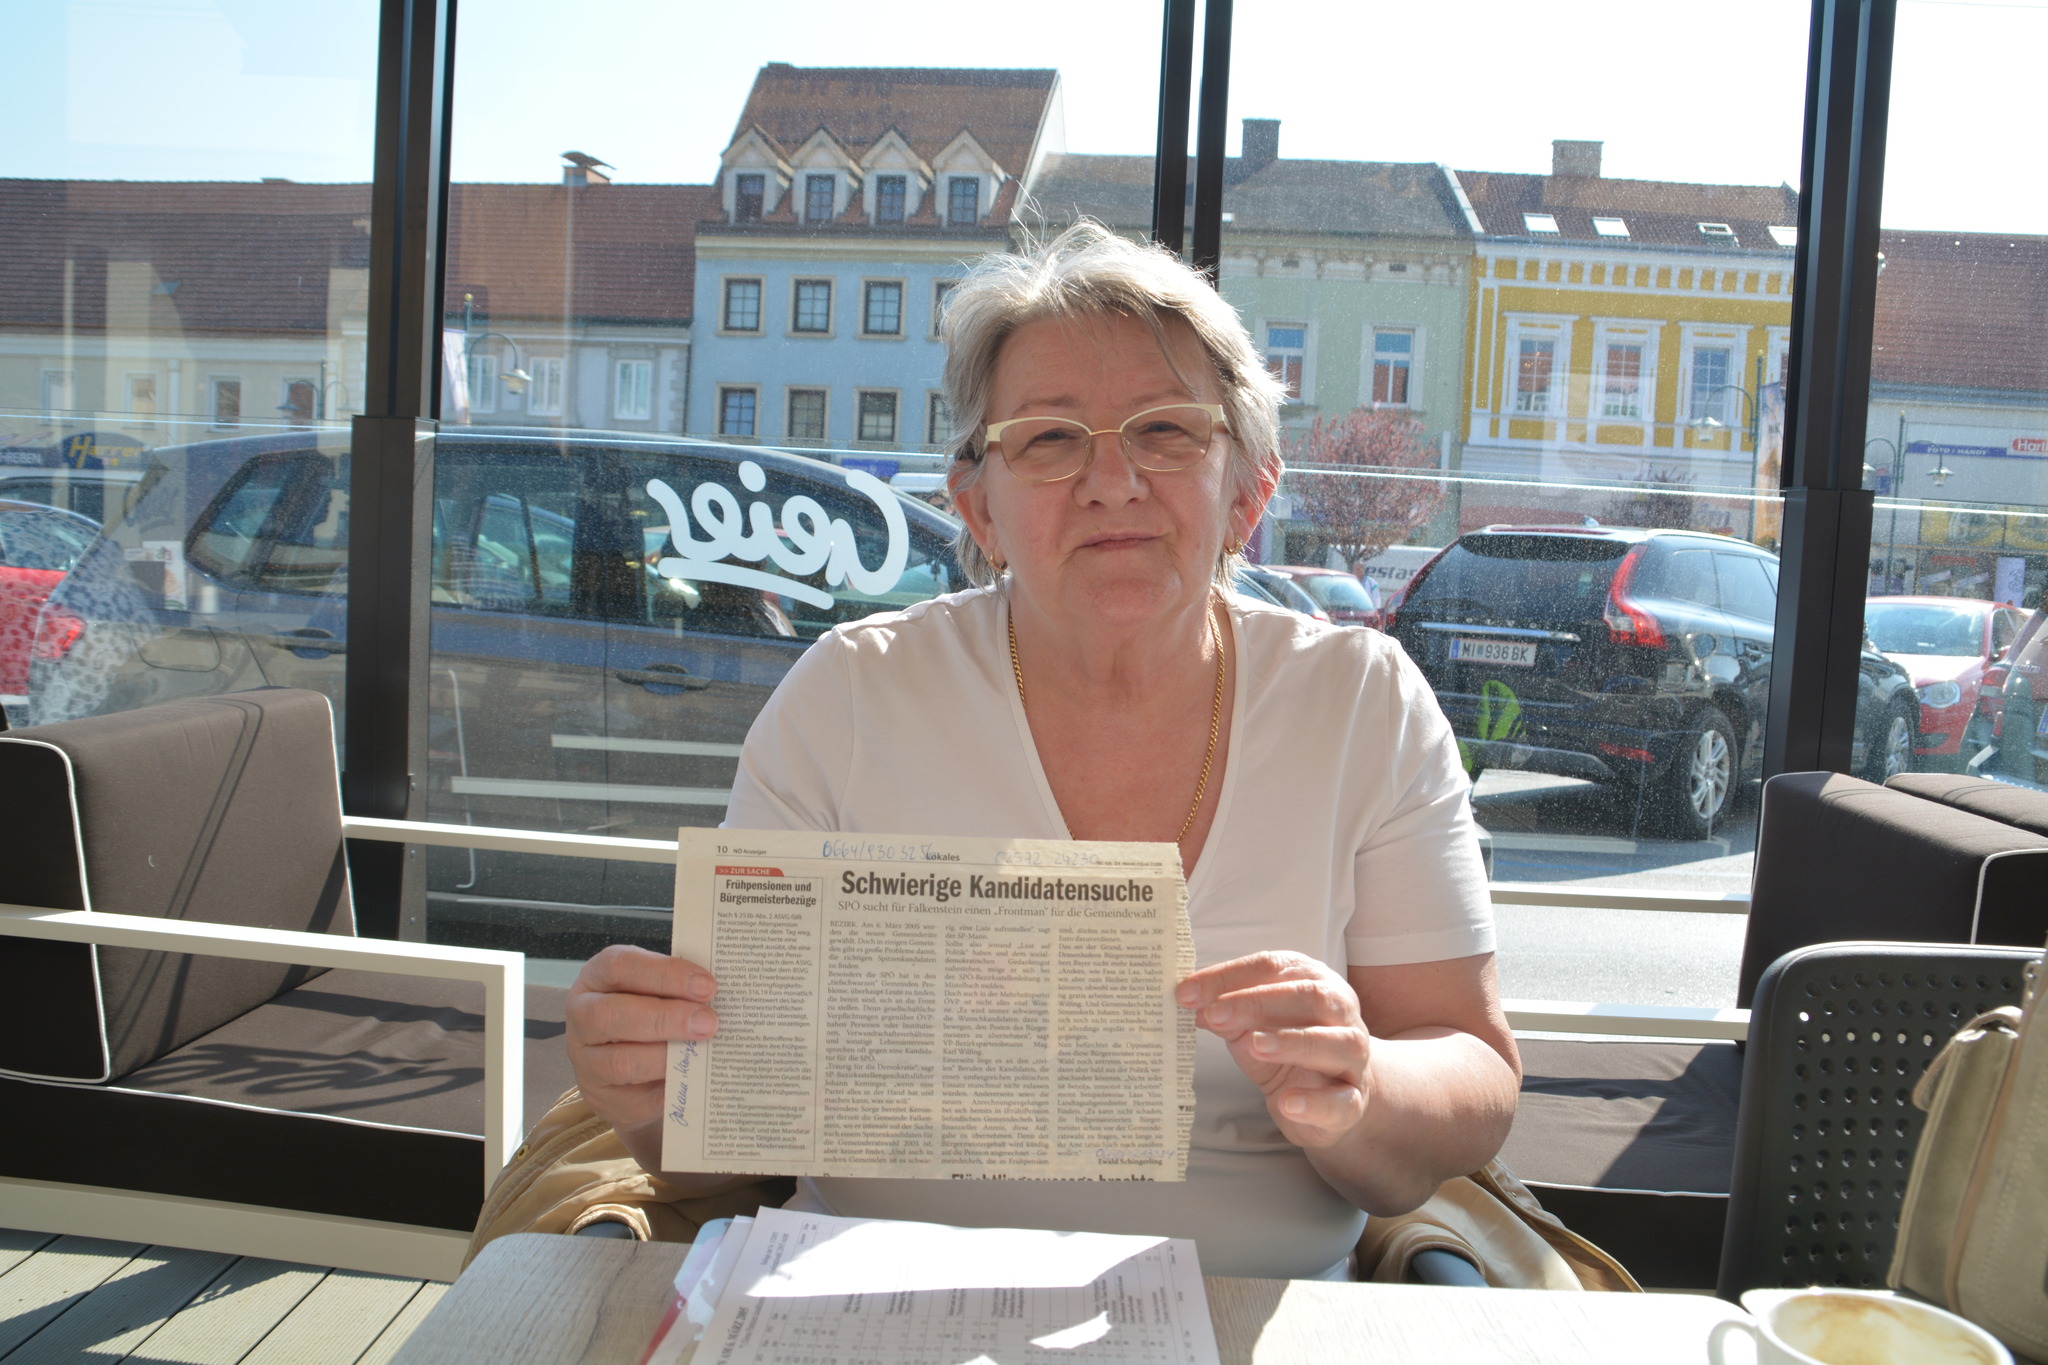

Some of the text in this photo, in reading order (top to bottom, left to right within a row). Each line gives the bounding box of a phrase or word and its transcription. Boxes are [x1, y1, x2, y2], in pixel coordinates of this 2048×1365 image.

[0, 452, 42, 464] HREIBEN
[68, 435, 143, 468] Harrer
[1461, 642, 1476, 657] MI
[926, 851, 960, 861] Lokales
[726, 879, 812, 892] Frühpensionen und
[840, 869, 1153, 904] Schwierige Kandidatensuche
[720, 893, 817, 908] Bürgermeisterbezüge
[837, 899, 860, 910] SPÖ
[862, 902, 888, 911] sucht
[891, 902, 905, 912] für
[908, 903, 962, 913] Falkenstein
[964, 906, 991, 914] einen
[1050, 907, 1065, 916] für
[1067, 907, 1081, 916] die
[1083, 907, 1156, 918] Gemeindewahl
